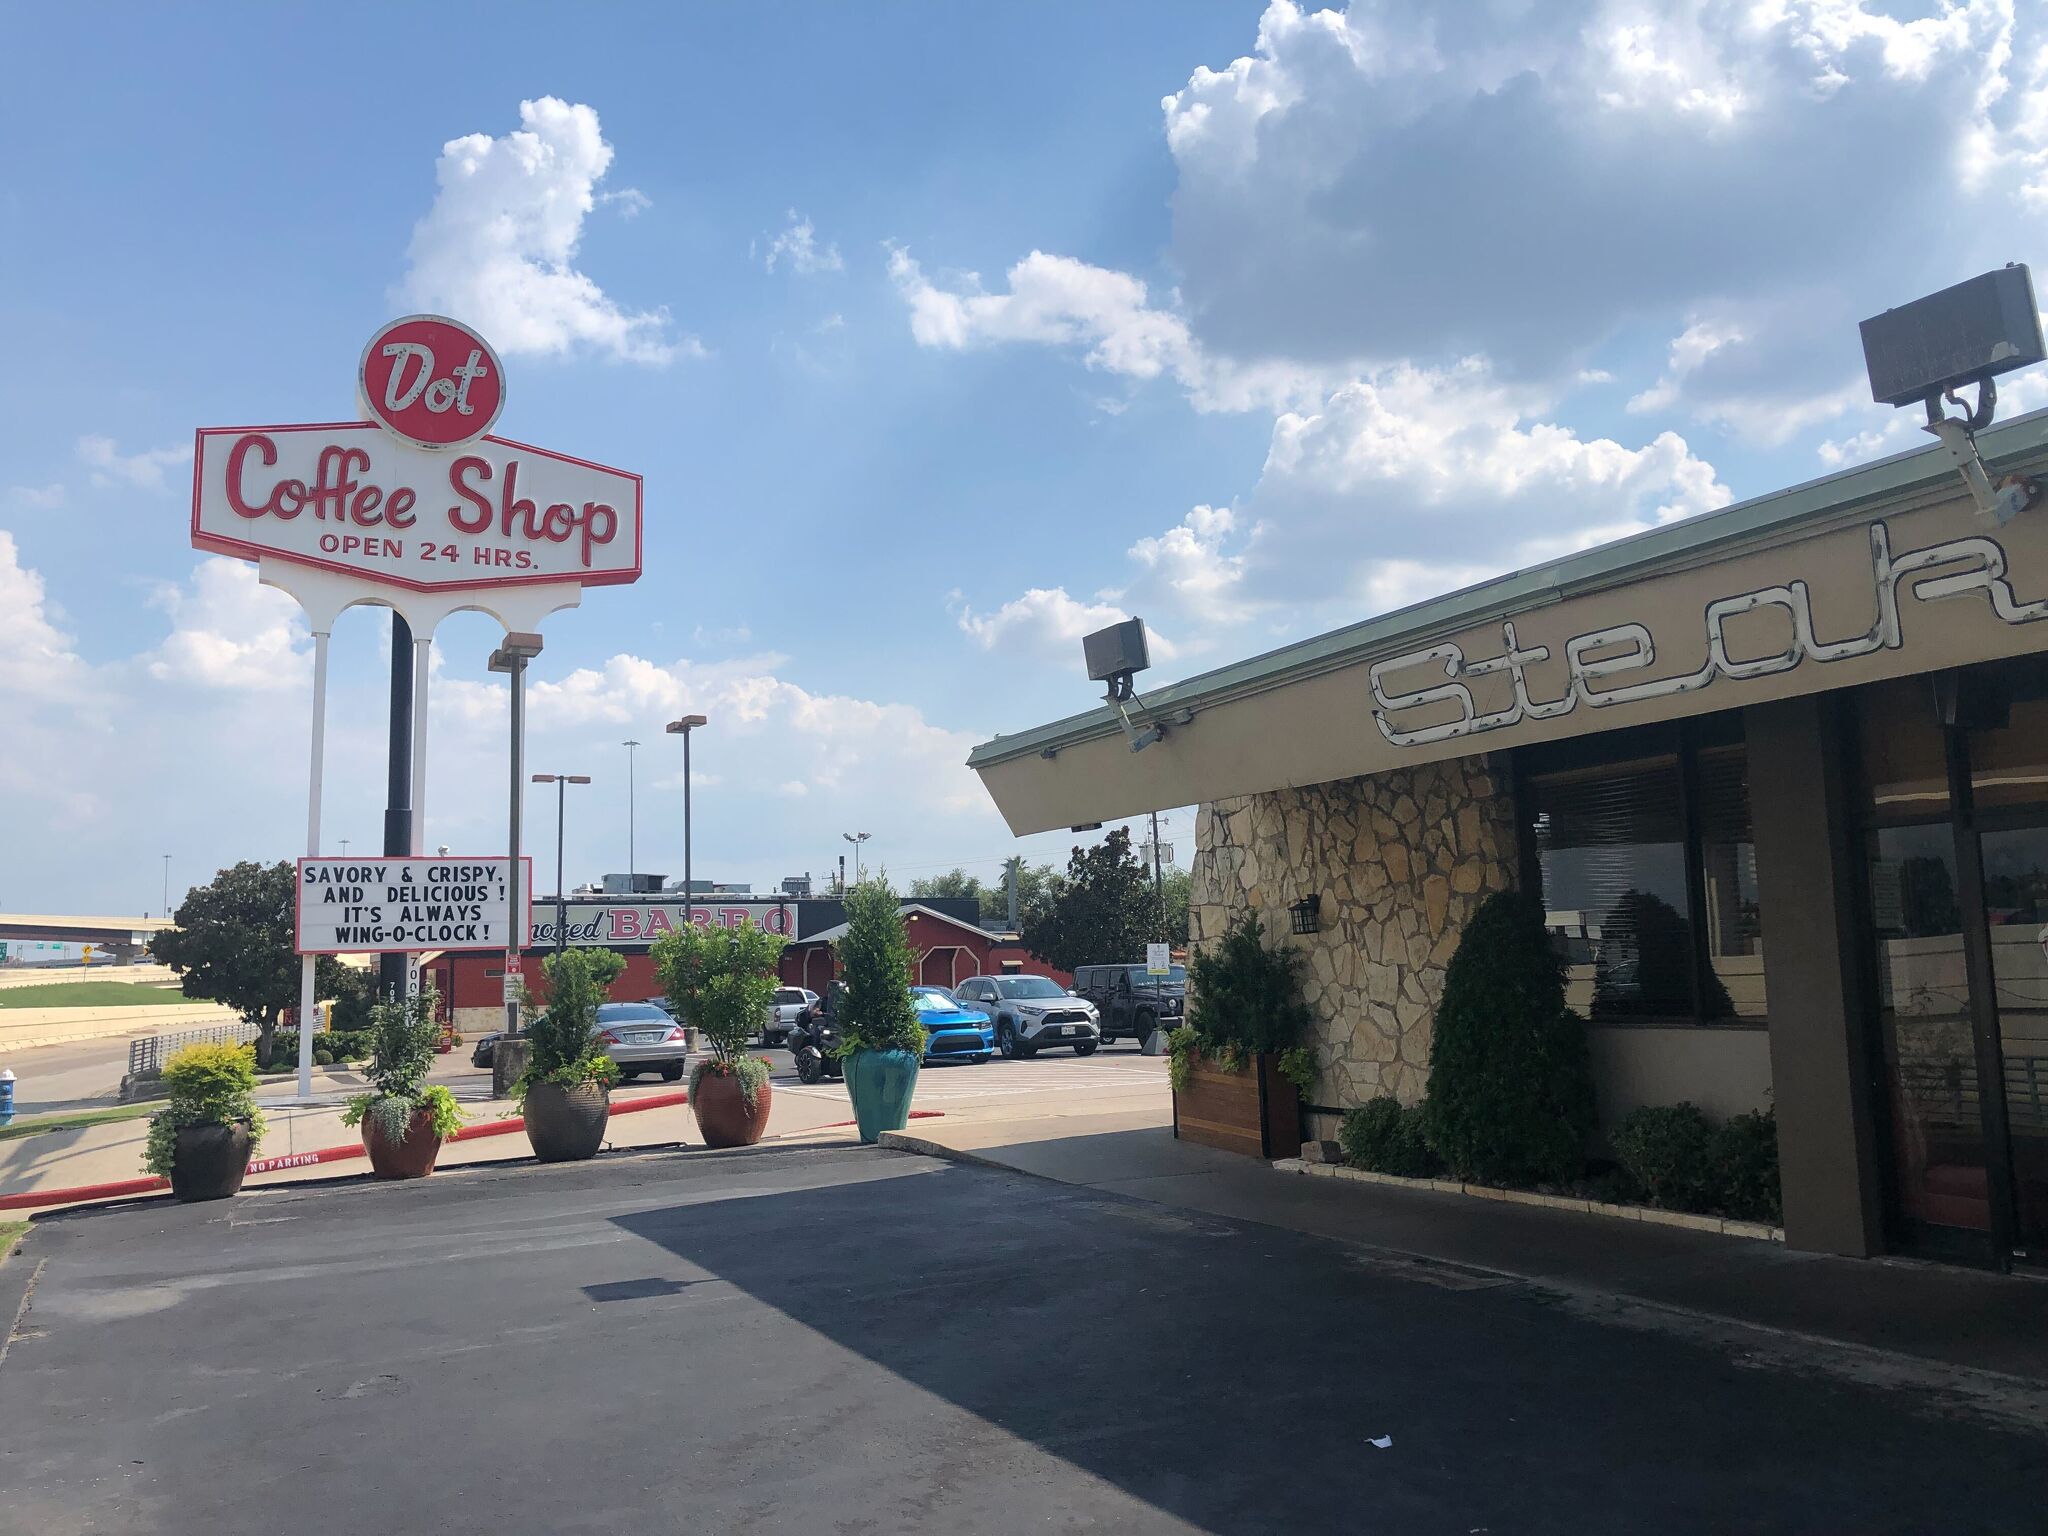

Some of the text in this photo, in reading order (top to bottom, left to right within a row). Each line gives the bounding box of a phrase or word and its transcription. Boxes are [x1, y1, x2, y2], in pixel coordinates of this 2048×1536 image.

[382, 342, 487, 416] Dot
[225, 433, 618, 567] Coffee Shop
[319, 533, 539, 570] OPEN 24 HRS.
[1368, 518, 2048, 747] Steak
[304, 866, 387, 884] SAVORY
[401, 866, 413, 883] &
[323, 887, 364, 903] AND
[344, 905, 482, 923] IT'S ALWAYS
[250, 1154, 319, 1173] NO PARKING
